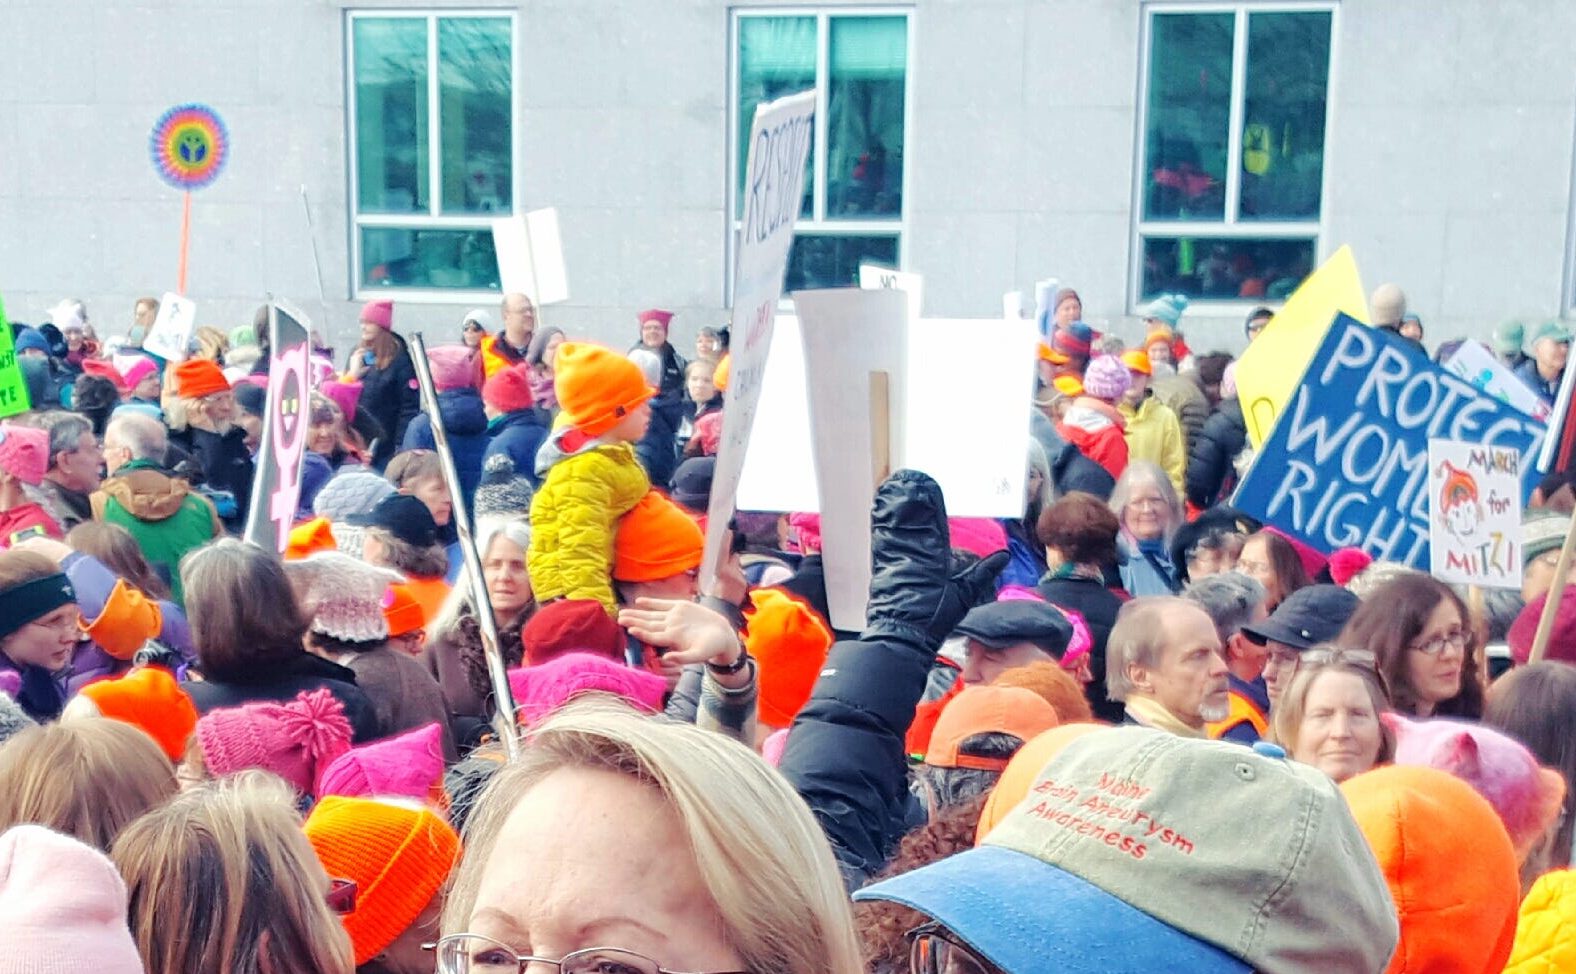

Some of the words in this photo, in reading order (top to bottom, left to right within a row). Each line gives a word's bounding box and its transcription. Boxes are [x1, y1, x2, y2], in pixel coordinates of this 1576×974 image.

[1467, 447, 1517, 476] MARCH
[1487, 489, 1510, 514] for
[1026, 801, 1149, 860] Awareness
[1033, 780, 1080, 803] Brain
[1079, 795, 1196, 855] Aneurysm
